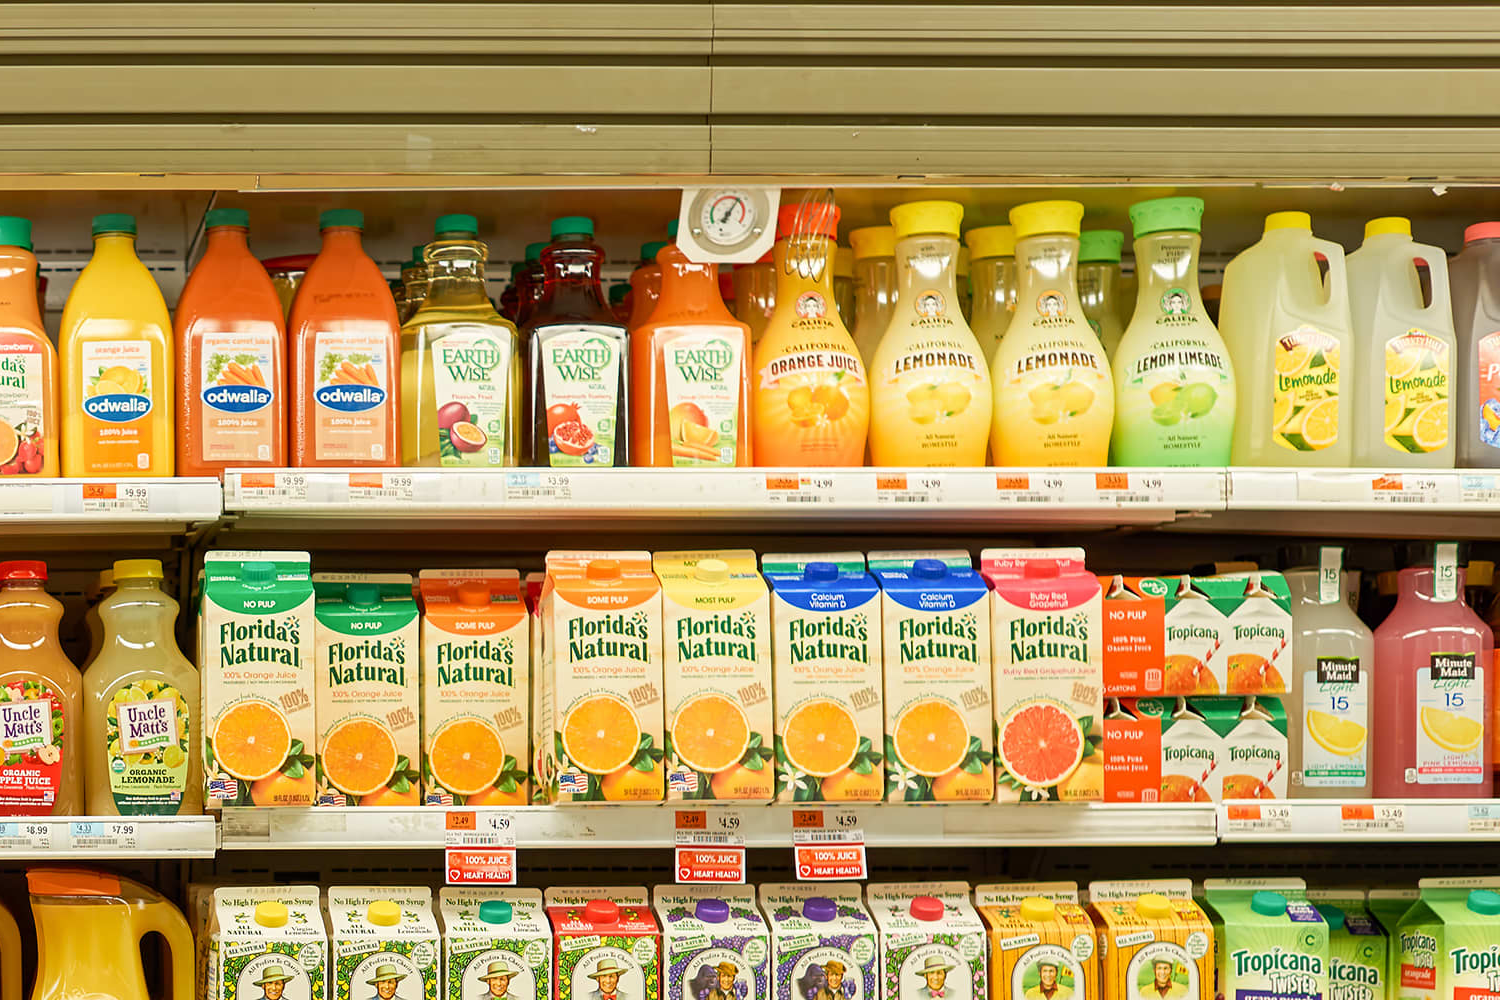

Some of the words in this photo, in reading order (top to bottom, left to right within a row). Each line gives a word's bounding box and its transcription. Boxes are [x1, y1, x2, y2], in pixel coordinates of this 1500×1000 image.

[442, 347, 497, 365] EARTH
[895, 351, 975, 374] LEMONADE
[1137, 354, 1175, 374] LEMON
[1178, 351, 1222, 370] LIMEADE
[448, 365, 491, 381] WISE
[771, 355, 825, 376] ORANGE
[827, 356, 857, 374] JUICE
[1279, 368, 1337, 392] Lemonade
[207, 388, 269, 404] odwalla
[88, 398, 148, 413] odwalla
[125, 488, 146, 498] $9.99
[810, 592, 845, 601] Calcium
[243, 600, 257, 608] NO
[258, 600, 276, 609] PULP
[1109, 610, 1123, 620] NO
[1125, 610, 1147, 620] PULP
[219, 617, 301, 646] Florida's
[1166, 625, 1219, 641] Tropicana
[219, 645, 301, 669] Natural
[1320, 659, 1358, 672] Minute
[1326, 670, 1353, 680] Maid
[121, 774, 175, 784] LEMONADE
[112, 824, 133, 835] $7.99
[489, 817, 510, 830] $4.59
[695, 855, 715, 864] 100%
[717, 855, 737, 864] JUICE
[692, 870, 713, 879] HEART
[714, 870, 739, 879] HEALTH
[1233, 948, 1322, 976] Tropicana
[1269, 972, 1317, 995] TWISTER
